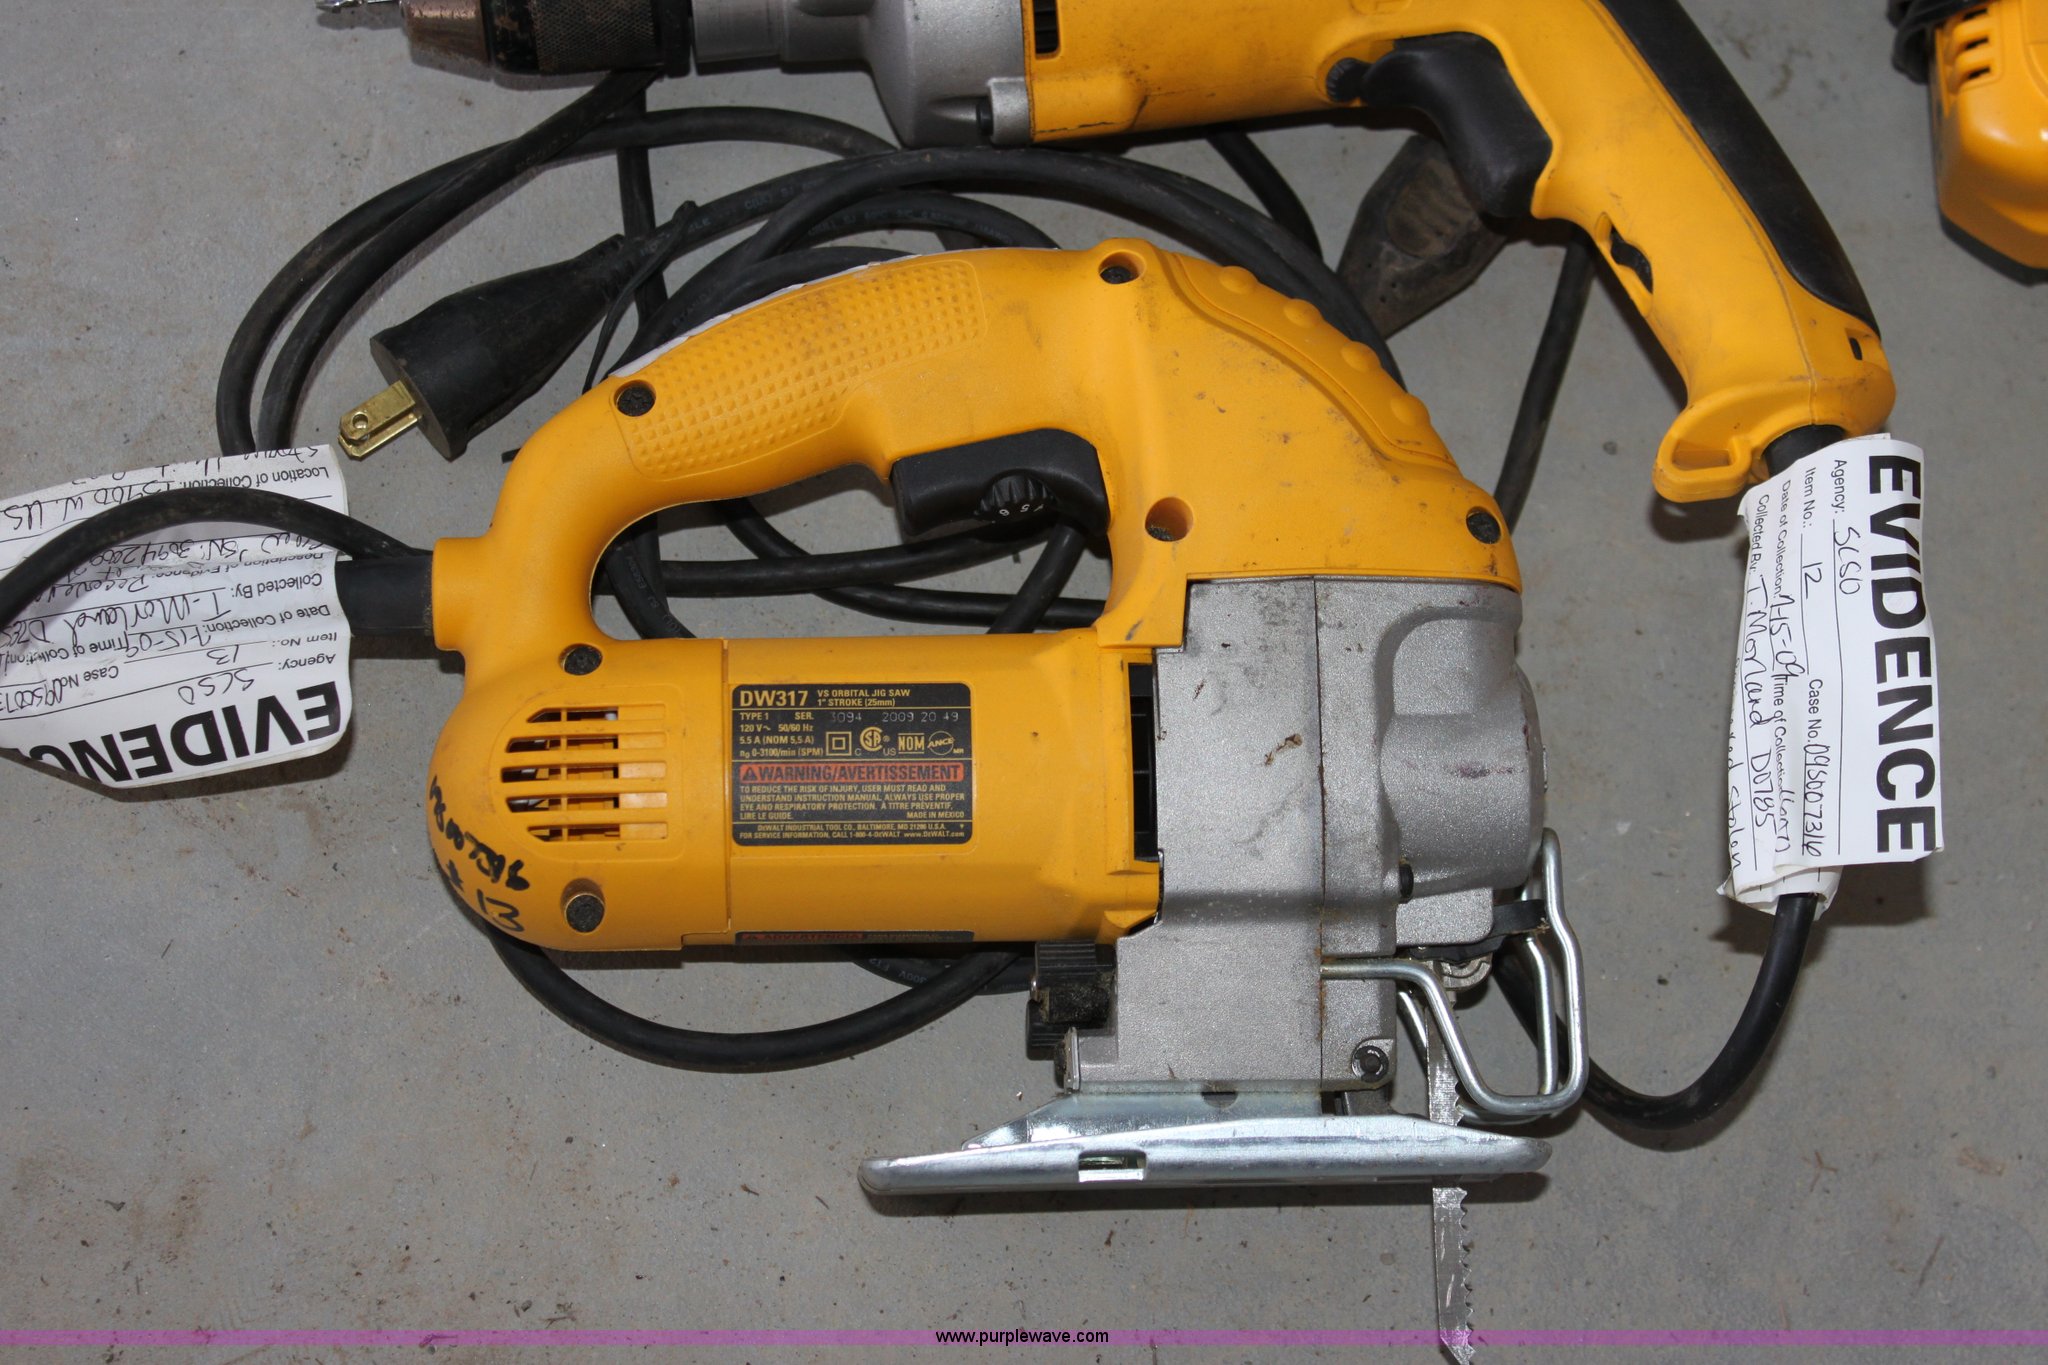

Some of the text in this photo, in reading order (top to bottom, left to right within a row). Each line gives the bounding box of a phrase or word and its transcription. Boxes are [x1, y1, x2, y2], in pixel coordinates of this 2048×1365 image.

[256, 474, 268, 487] of
[272, 467, 329, 483] Location
[1831, 460, 1847, 514] Agency:
[1779, 480, 1792, 513] Date
[1802, 467, 1816, 528] Item No.:
[1752, 495, 1770, 550] Collected
[1778, 515, 1788, 526] of
[230, 573, 322, 599] Collected By:
[1803, 562, 1823, 599] 12
[202, 604, 330, 634] Date of Collection:
[89, 636, 127, 651] Time
[272, 632, 337, 647] Item No.:
[72, 645, 85, 657] of
[207, 644, 239, 665] 13
[1869, 456, 1936, 853] EVIDENCE
[278, 653, 336, 670] Agency:
[83, 665, 119, 681] Case
[740, 689, 808, 707] DW317
[817, 689, 911, 698] VS ORBITAL JIG SAW
[1773, 677, 1788, 706] Time
[828, 698, 863, 707] STROKE
[865, 698, 896, 707] (25mm)
[740, 712, 769, 720] TYPE 1
[794, 711, 815, 720] SER.
[882, 711, 914, 722] 2009
[920, 711, 937, 722] 20
[1772, 711, 1787, 723] of
[1807, 679, 1823, 743] Case No.
[29, 681, 341, 782] EVIDENC
[740, 724, 755, 732] 120
[802, 723, 814, 732] Hz
[754, 735, 760, 744] A
[898, 736, 925, 751] NOM
[758, 765, 960, 781] WARNING/AVERTISSEMENT
[752, 785, 780, 793] REDUCE
[784, 785, 797, 793] THE
[800, 785, 816, 793] RISK
[819, 785, 829, 793] OF
[907, 784, 927, 792] READ
[929, 784, 946, 792] AND
[740, 794, 792, 802] UNDERSTAND
[794, 794, 845, 802] INSTRUCTION
[885, 793, 916, 801] ALWAYS
[919, 793, 934, 801] USE
[756, 803, 773, 811] AND
[774, 803, 826, 811] RESPIRATORY
